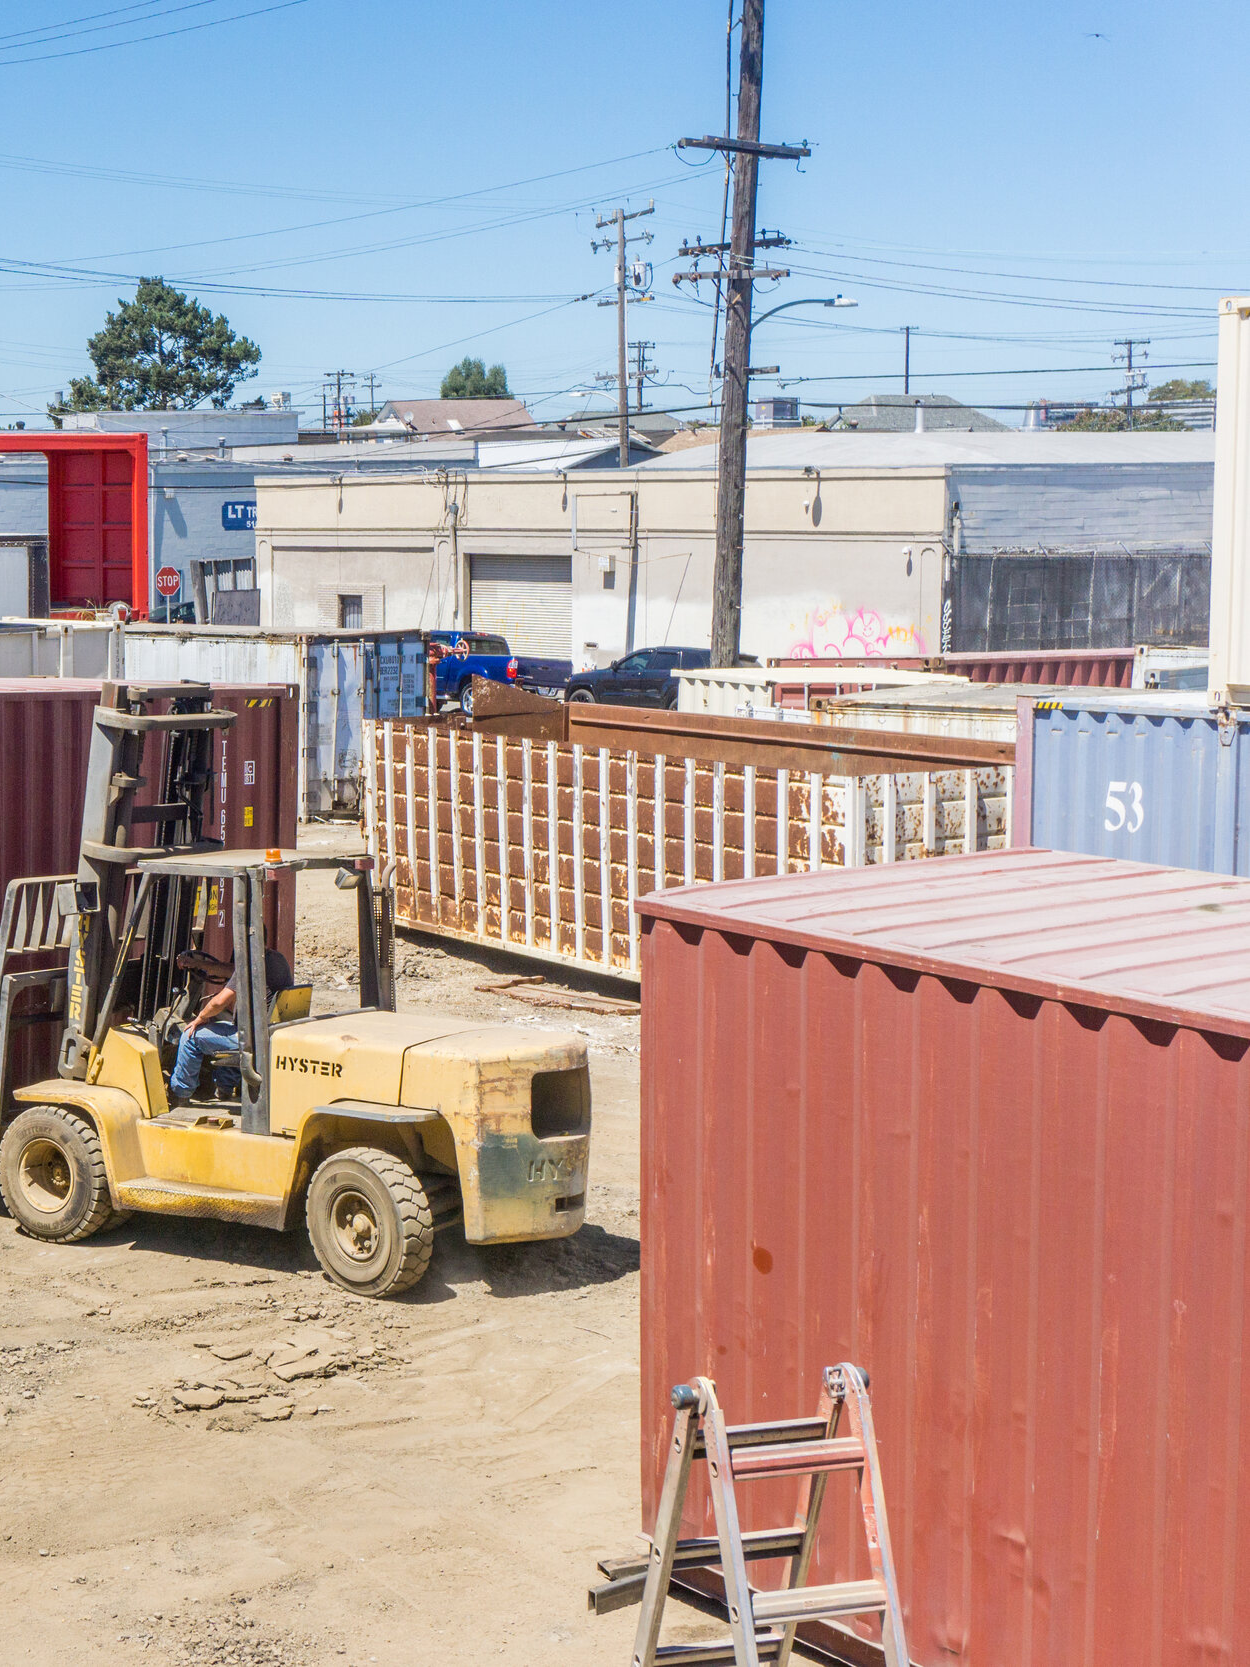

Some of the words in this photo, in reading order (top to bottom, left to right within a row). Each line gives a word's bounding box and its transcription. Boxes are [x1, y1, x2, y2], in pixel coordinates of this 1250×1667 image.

[228, 505, 244, 519] LT
[157, 576, 179, 587] STOP
[1104, 781, 1144, 833] 53
[69, 913, 90, 1020] HYSTER
[276, 1055, 343, 1078] HYSTER
